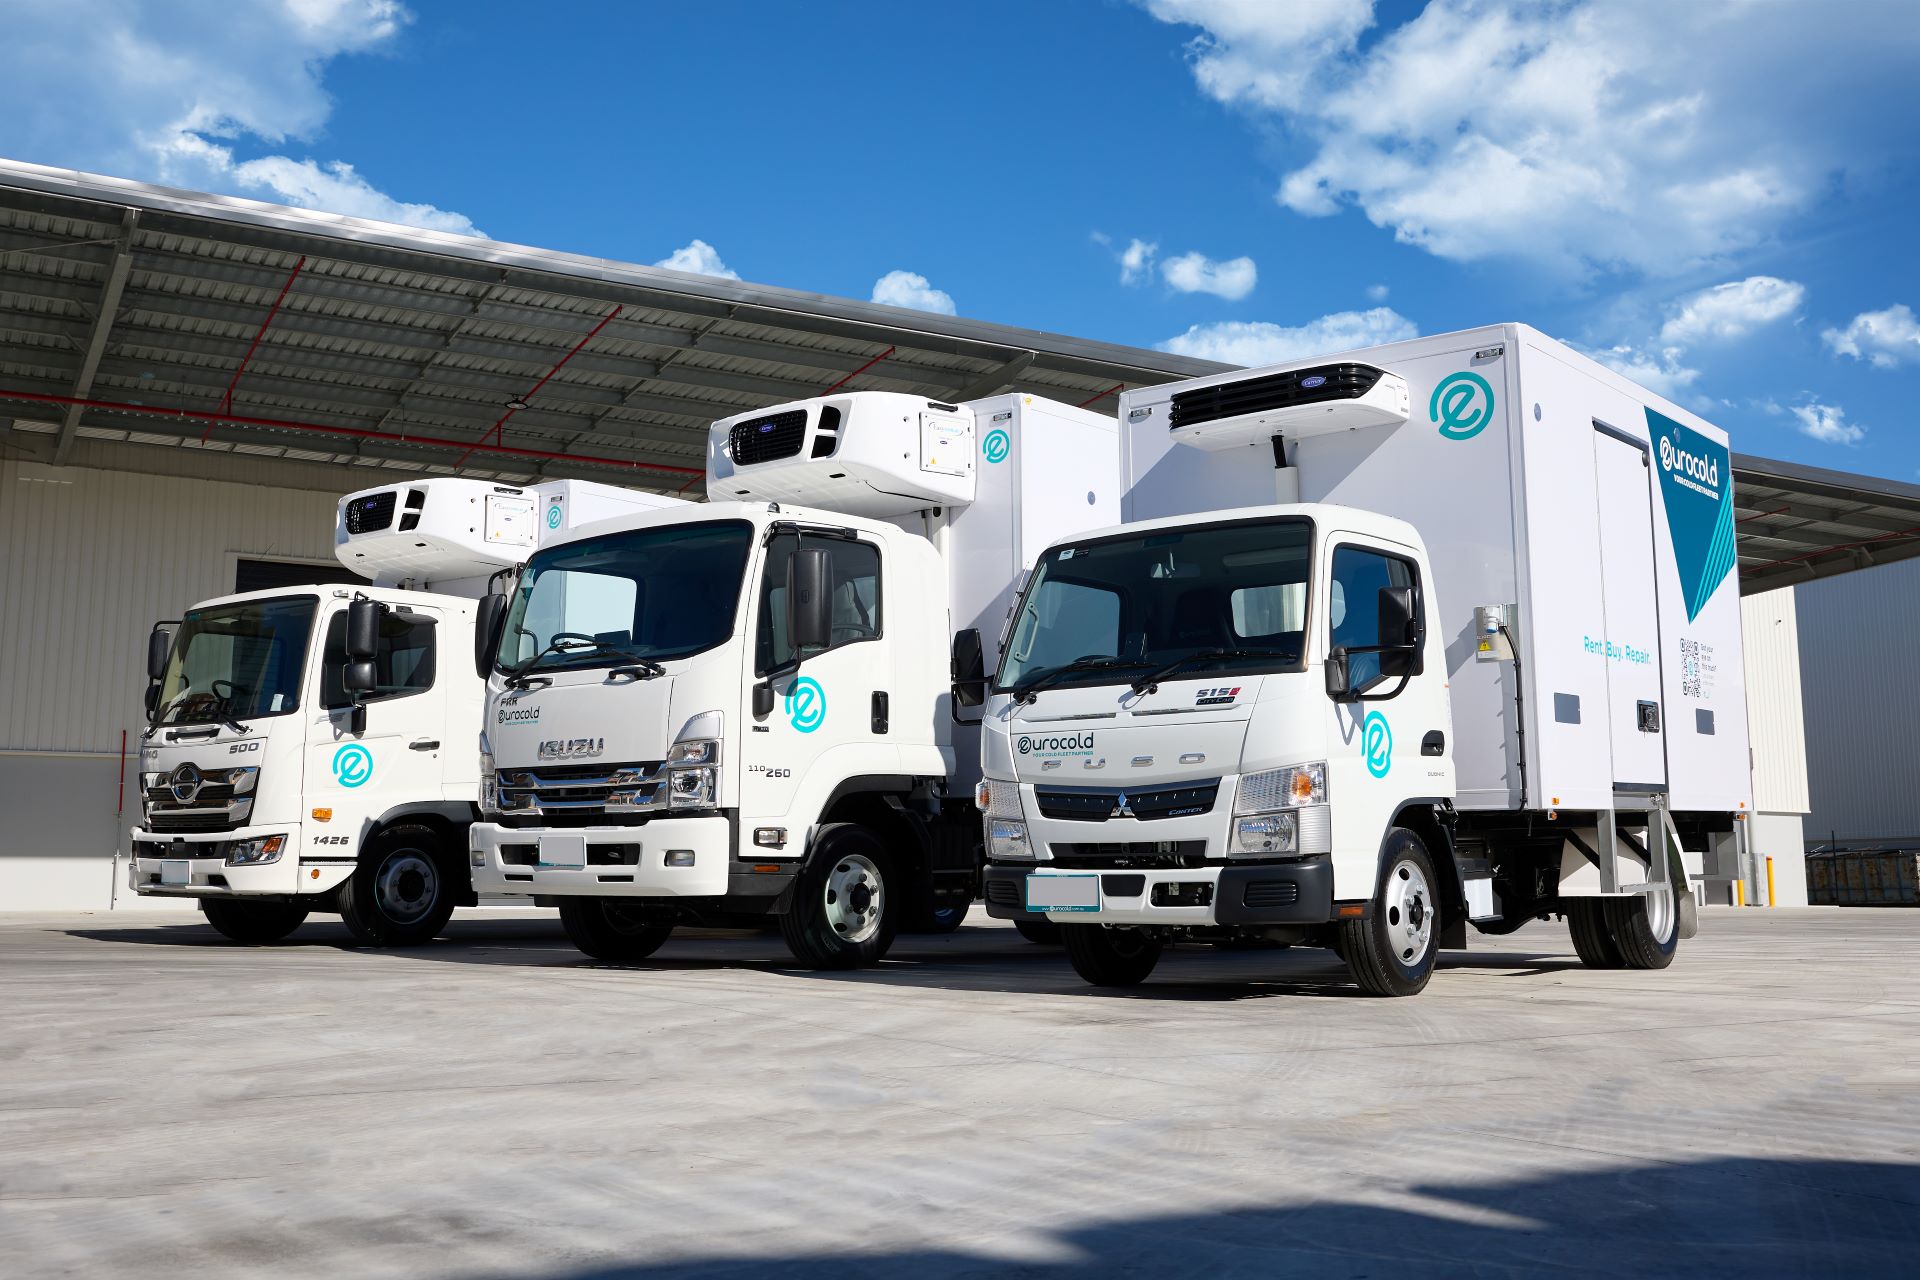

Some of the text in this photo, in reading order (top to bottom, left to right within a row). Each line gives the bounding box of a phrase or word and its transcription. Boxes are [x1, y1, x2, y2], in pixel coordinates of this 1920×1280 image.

[1660, 435, 1719, 487] eurocold
[1584, 635, 1604, 655] Rent.
[1606, 641, 1624, 662] Buy.
[501, 697, 519, 706] FRR
[498, 706, 541, 724] eurocold
[229, 742, 259, 754] 500
[538, 737, 604, 761] ISUZU
[1018, 731, 1094, 754] eurocold
[1041, 752, 1206, 771] FUSO
[766, 769, 791, 778] 260
[1168, 807, 1203, 816] CANTER
[313, 836, 349, 845] 1426
